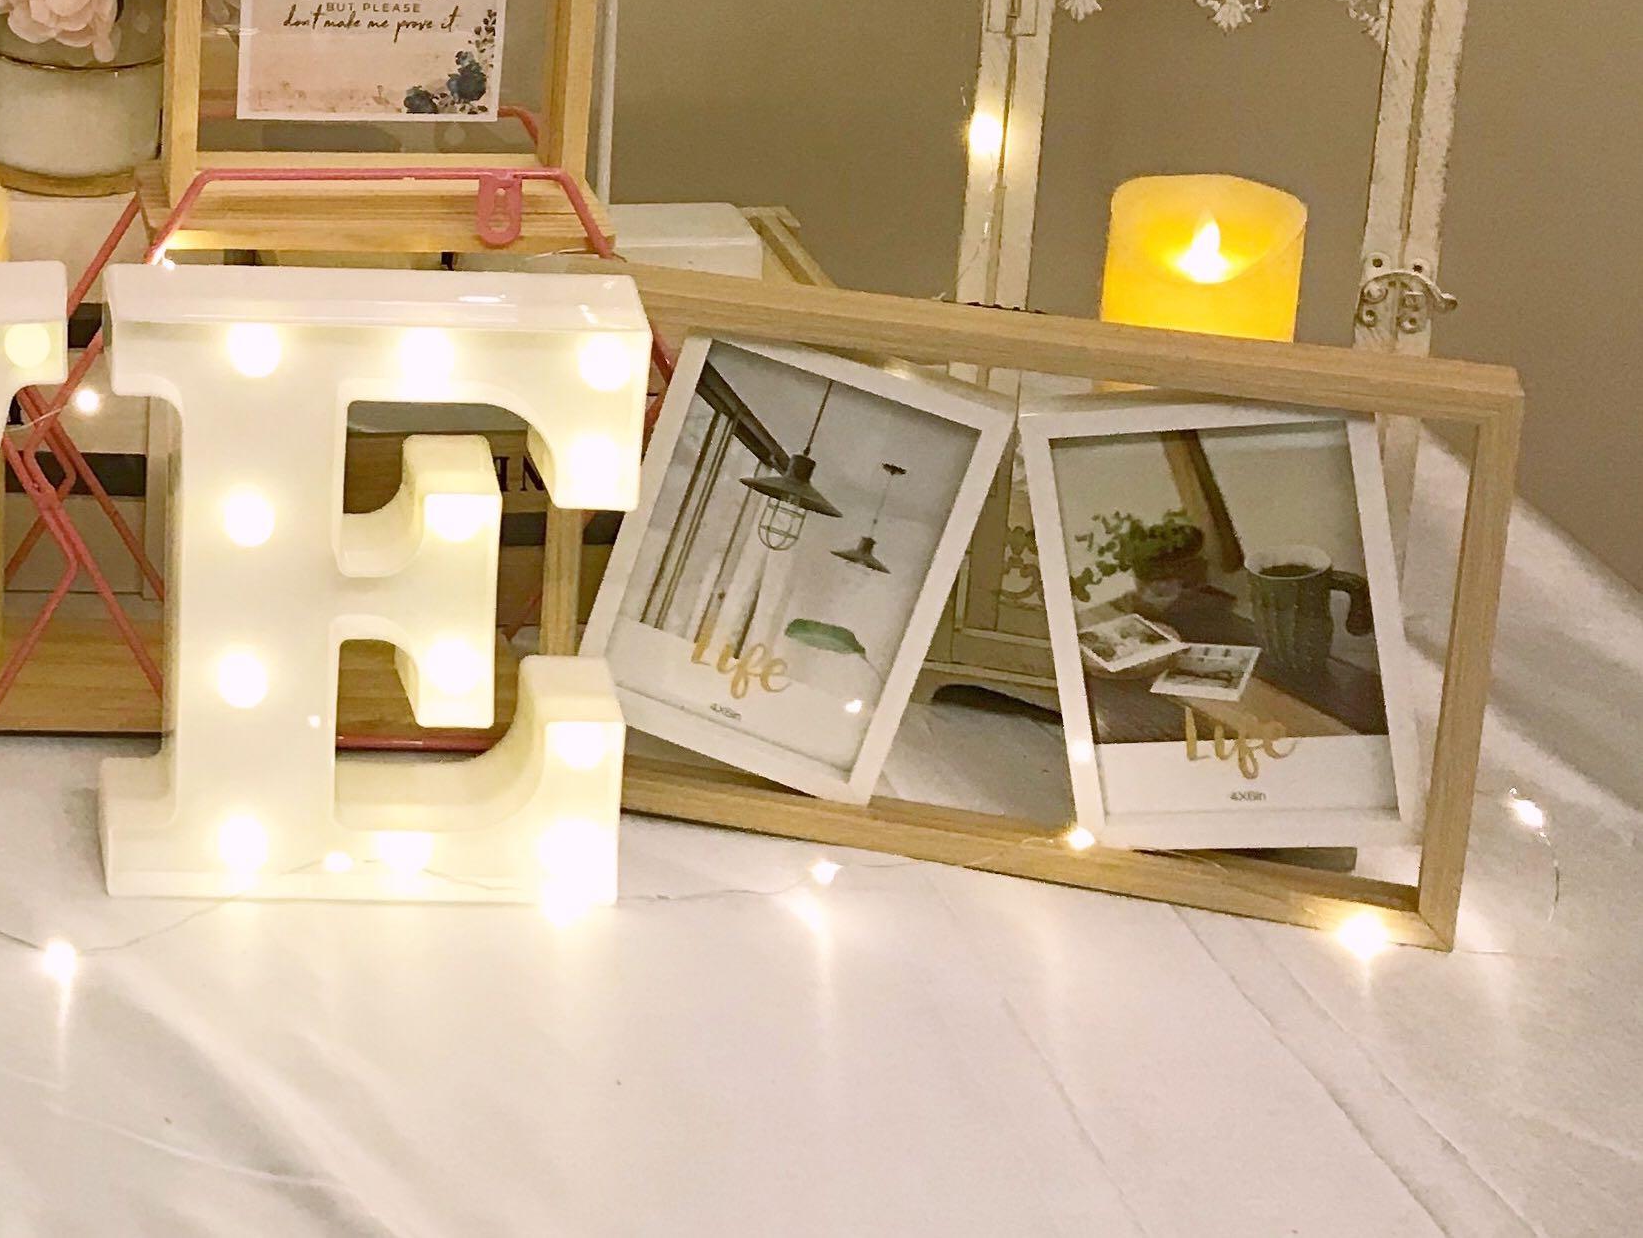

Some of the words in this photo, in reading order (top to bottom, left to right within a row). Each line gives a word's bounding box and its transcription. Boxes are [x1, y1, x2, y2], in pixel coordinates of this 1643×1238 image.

[322, 11, 361, 29] make
[366, 17, 390, 30] me
[392, 17, 434, 44] prove
[439, 5, 463, 33] it
[325, 1, 355, 14] BUT
[362, 1, 421, 14] PLEASE
[690, 624, 792, 700] Life
[1184, 706, 1299, 780] Life
